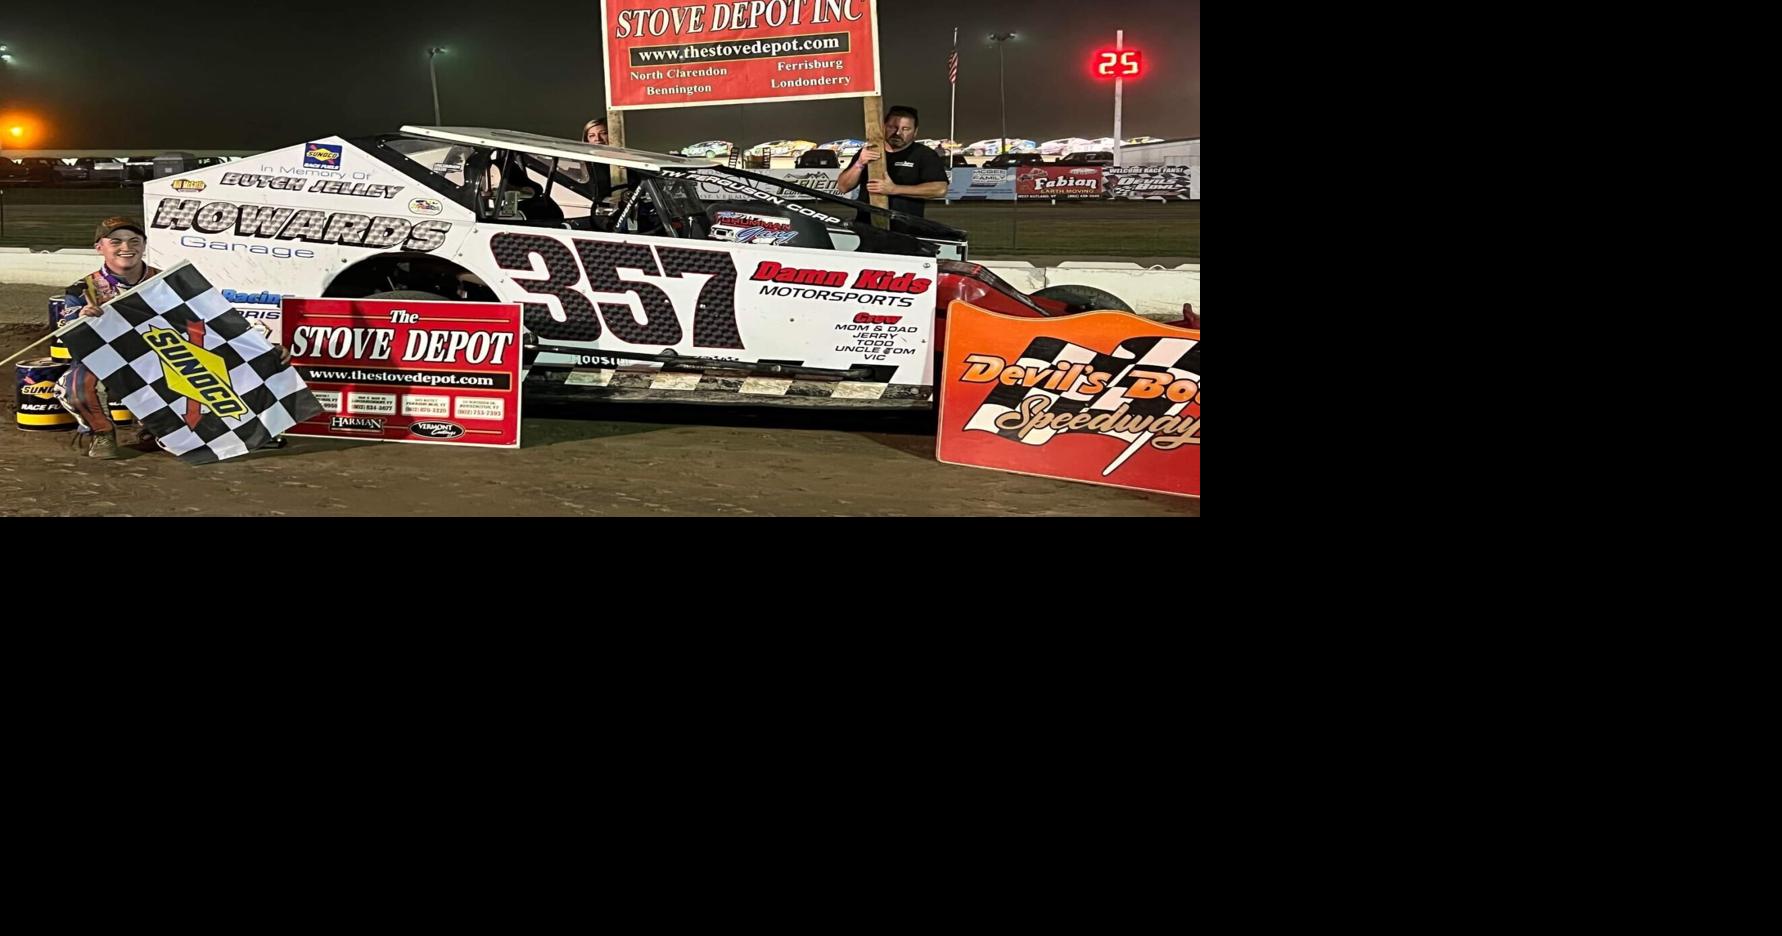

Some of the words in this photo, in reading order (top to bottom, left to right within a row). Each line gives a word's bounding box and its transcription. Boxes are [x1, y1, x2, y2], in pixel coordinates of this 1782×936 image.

[615, 4, 706, 38] STOVE
[710, 0, 807, 32] DEPOT
[811, 0, 863, 24] INC
[638, 36, 840, 62] www.thestovedepot.com
[777, 59, 844, 71] Ferrisburg
[1098, 51, 1139, 75] 25
[630, 69, 663, 81] North
[666, 66, 728, 78] Clarendon
[771, 74, 851, 89] Londonderry
[646, 84, 712, 96] Bennington
[260, 164, 273, 172] In
[279, 165, 346, 179] Memory
[352, 171, 371, 180] Of
[219, 171, 307, 192] BUTCH
[307, 179, 405, 199] JELLEY
[1034, 175, 1097, 190] Fabian
[661, 169, 685, 178] TW
[686, 173, 785, 206] FERGUSON
[786, 203, 841, 225] CORP
[151, 197, 453, 252] HOWARDS
[180, 235, 315, 258] Garage
[749, 260, 849, 288] Damn
[851, 268, 932, 295] Kids
[221, 289, 281, 305] Racin
[490, 231, 746, 350] 357
[758, 285, 915, 308] MOTORSPORTS
[389, 309, 420, 325] The
[852, 312, 903, 325] Crew
[852, 332, 898, 340] JERRY
[857, 339, 895, 347] TODD
[289, 324, 395, 361] STOVE
[402, 329, 514, 366] DEPOT
[835, 345, 880, 354] UNCLE
[150, 331, 244, 413] SUNOCO
[309, 370, 495, 387] www.thestovedepot.com
[960, 353, 1113, 395] Devil's
[1121, 369, 1200, 405] Bo
[21, 403, 46, 411] RACE
[332, 416, 381, 429] HARMAN
[995, 394, 1200, 451] Speedway
